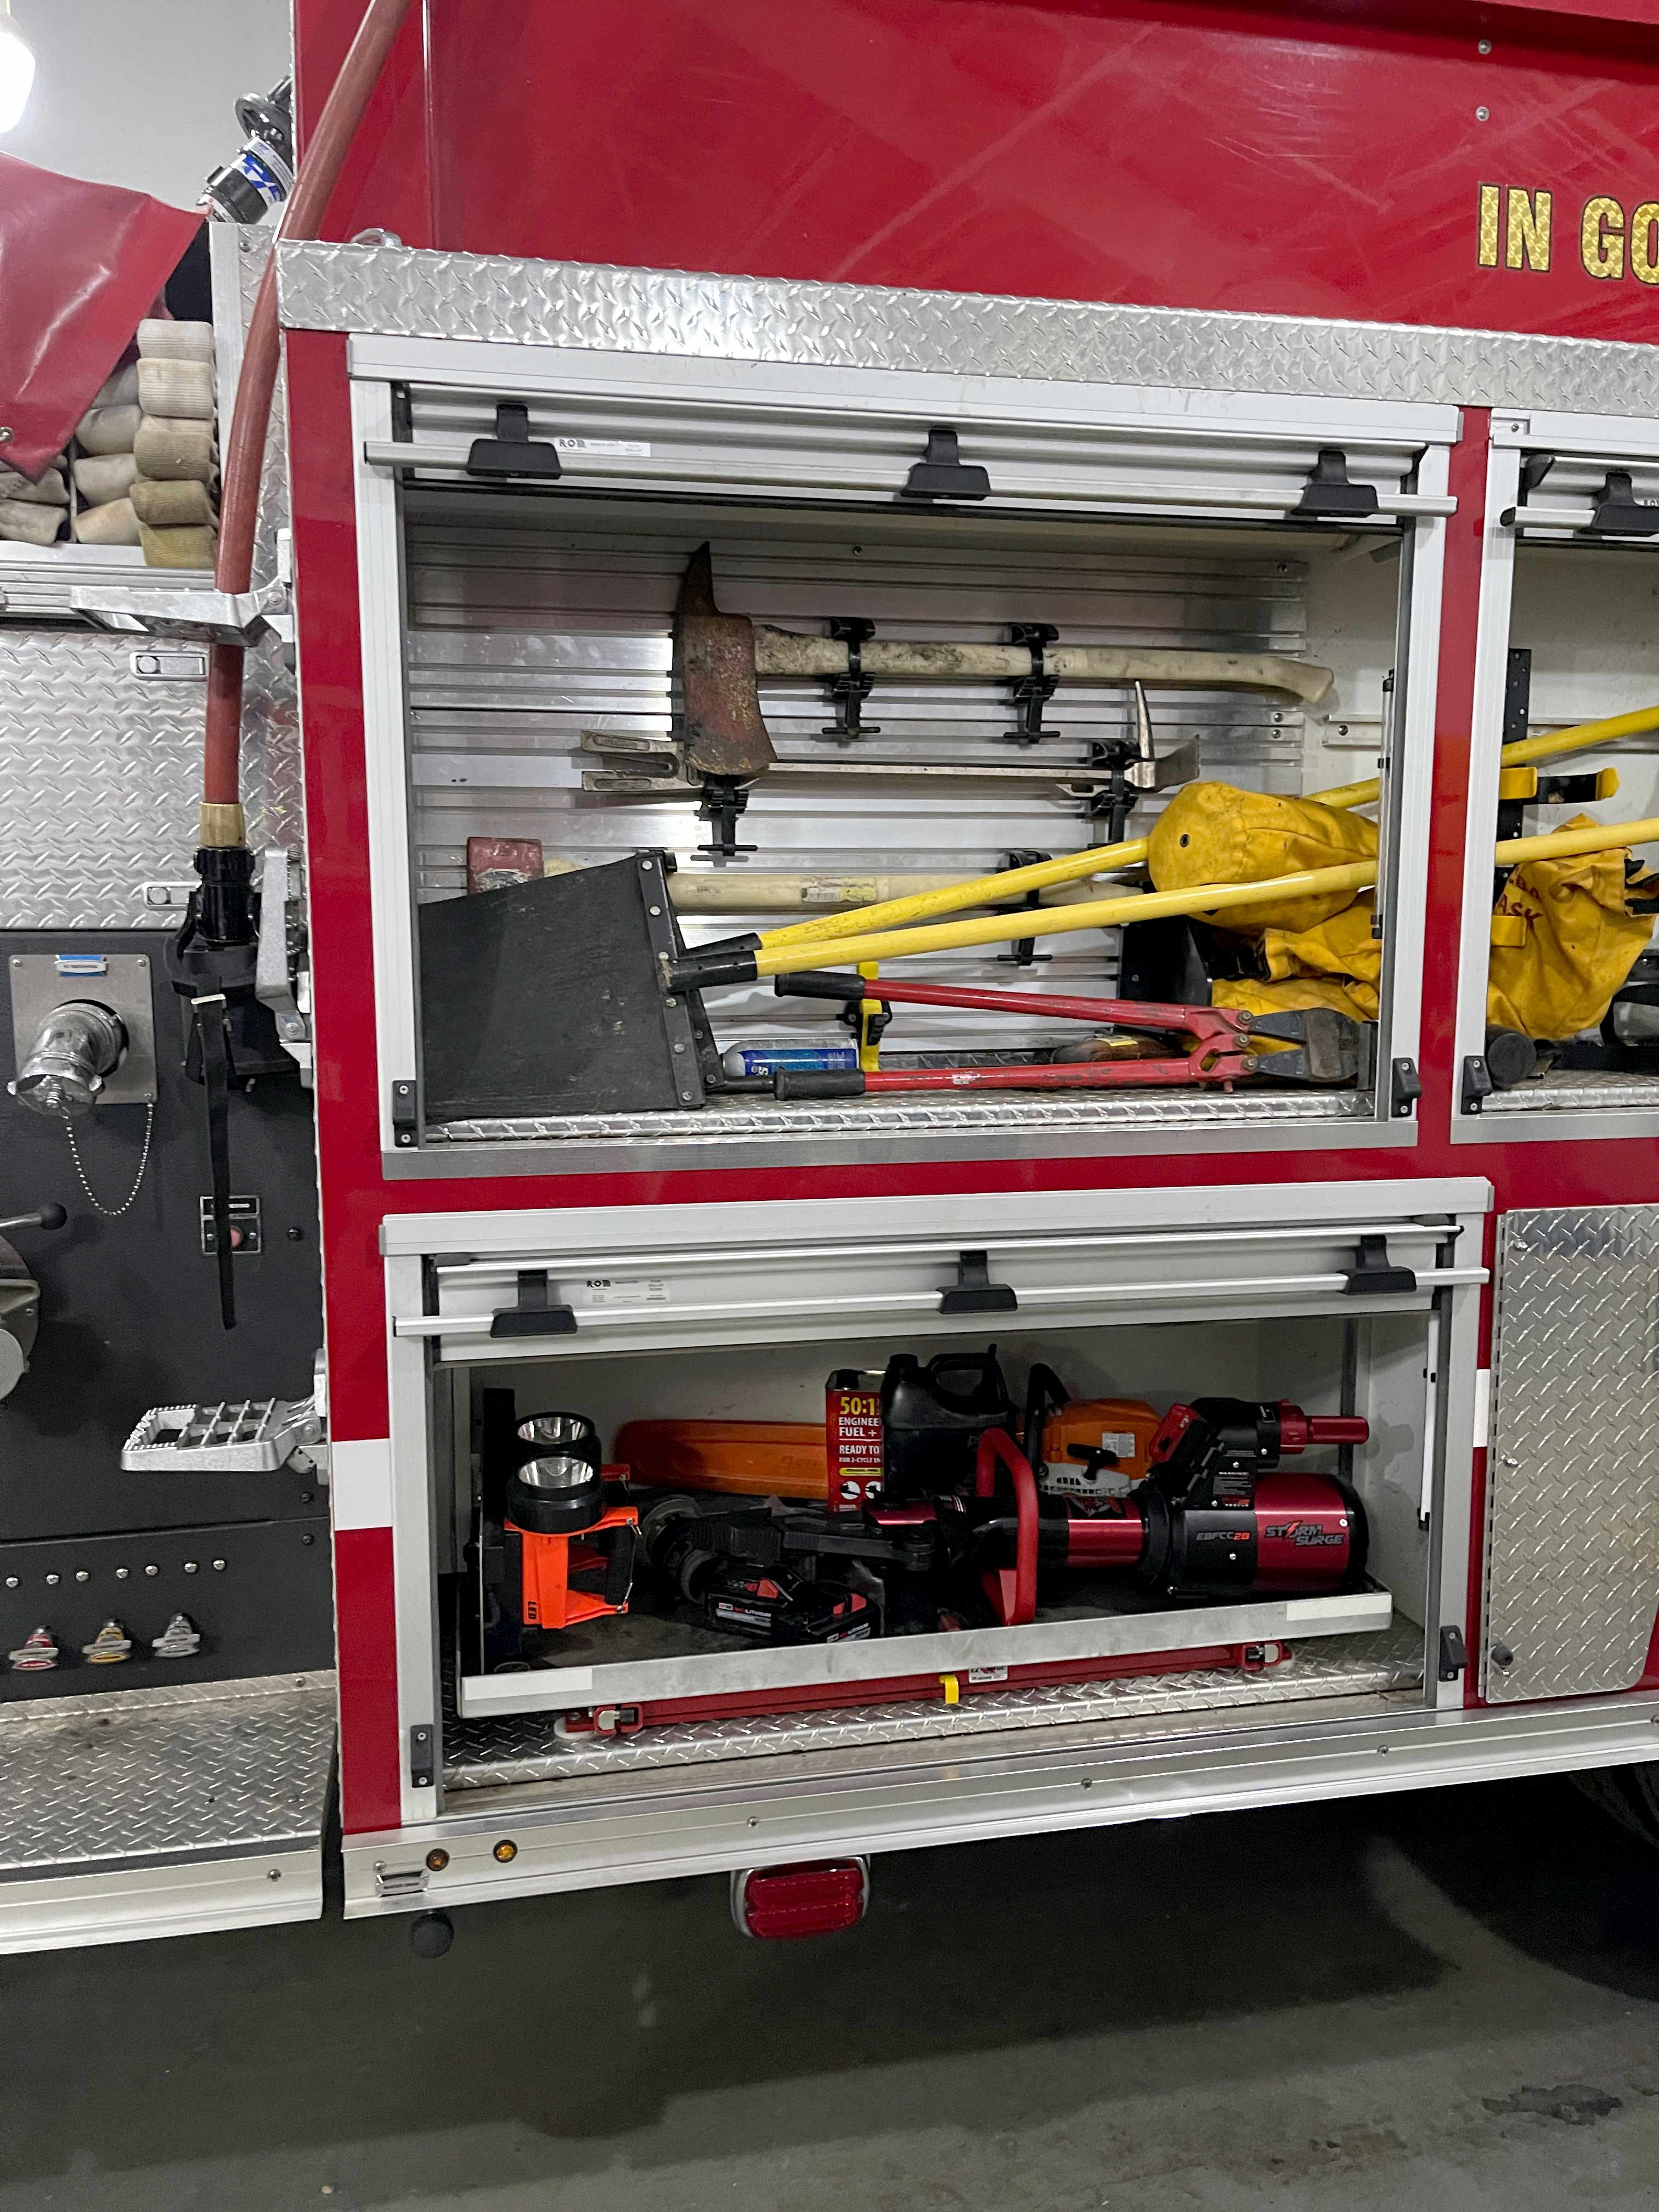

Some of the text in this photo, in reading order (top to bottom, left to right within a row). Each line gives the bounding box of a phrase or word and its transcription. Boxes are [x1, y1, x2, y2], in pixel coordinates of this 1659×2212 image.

[1478, 184, 1659, 286] IN GO
[839, 1396, 875, 1416] 50:1
[839, 1426, 866, 1437] FUEL
[839, 1444, 880, 1455] READY TO
[1295, 1533, 1345, 1546] SURGE
[527, 1601, 538, 1620] LED
